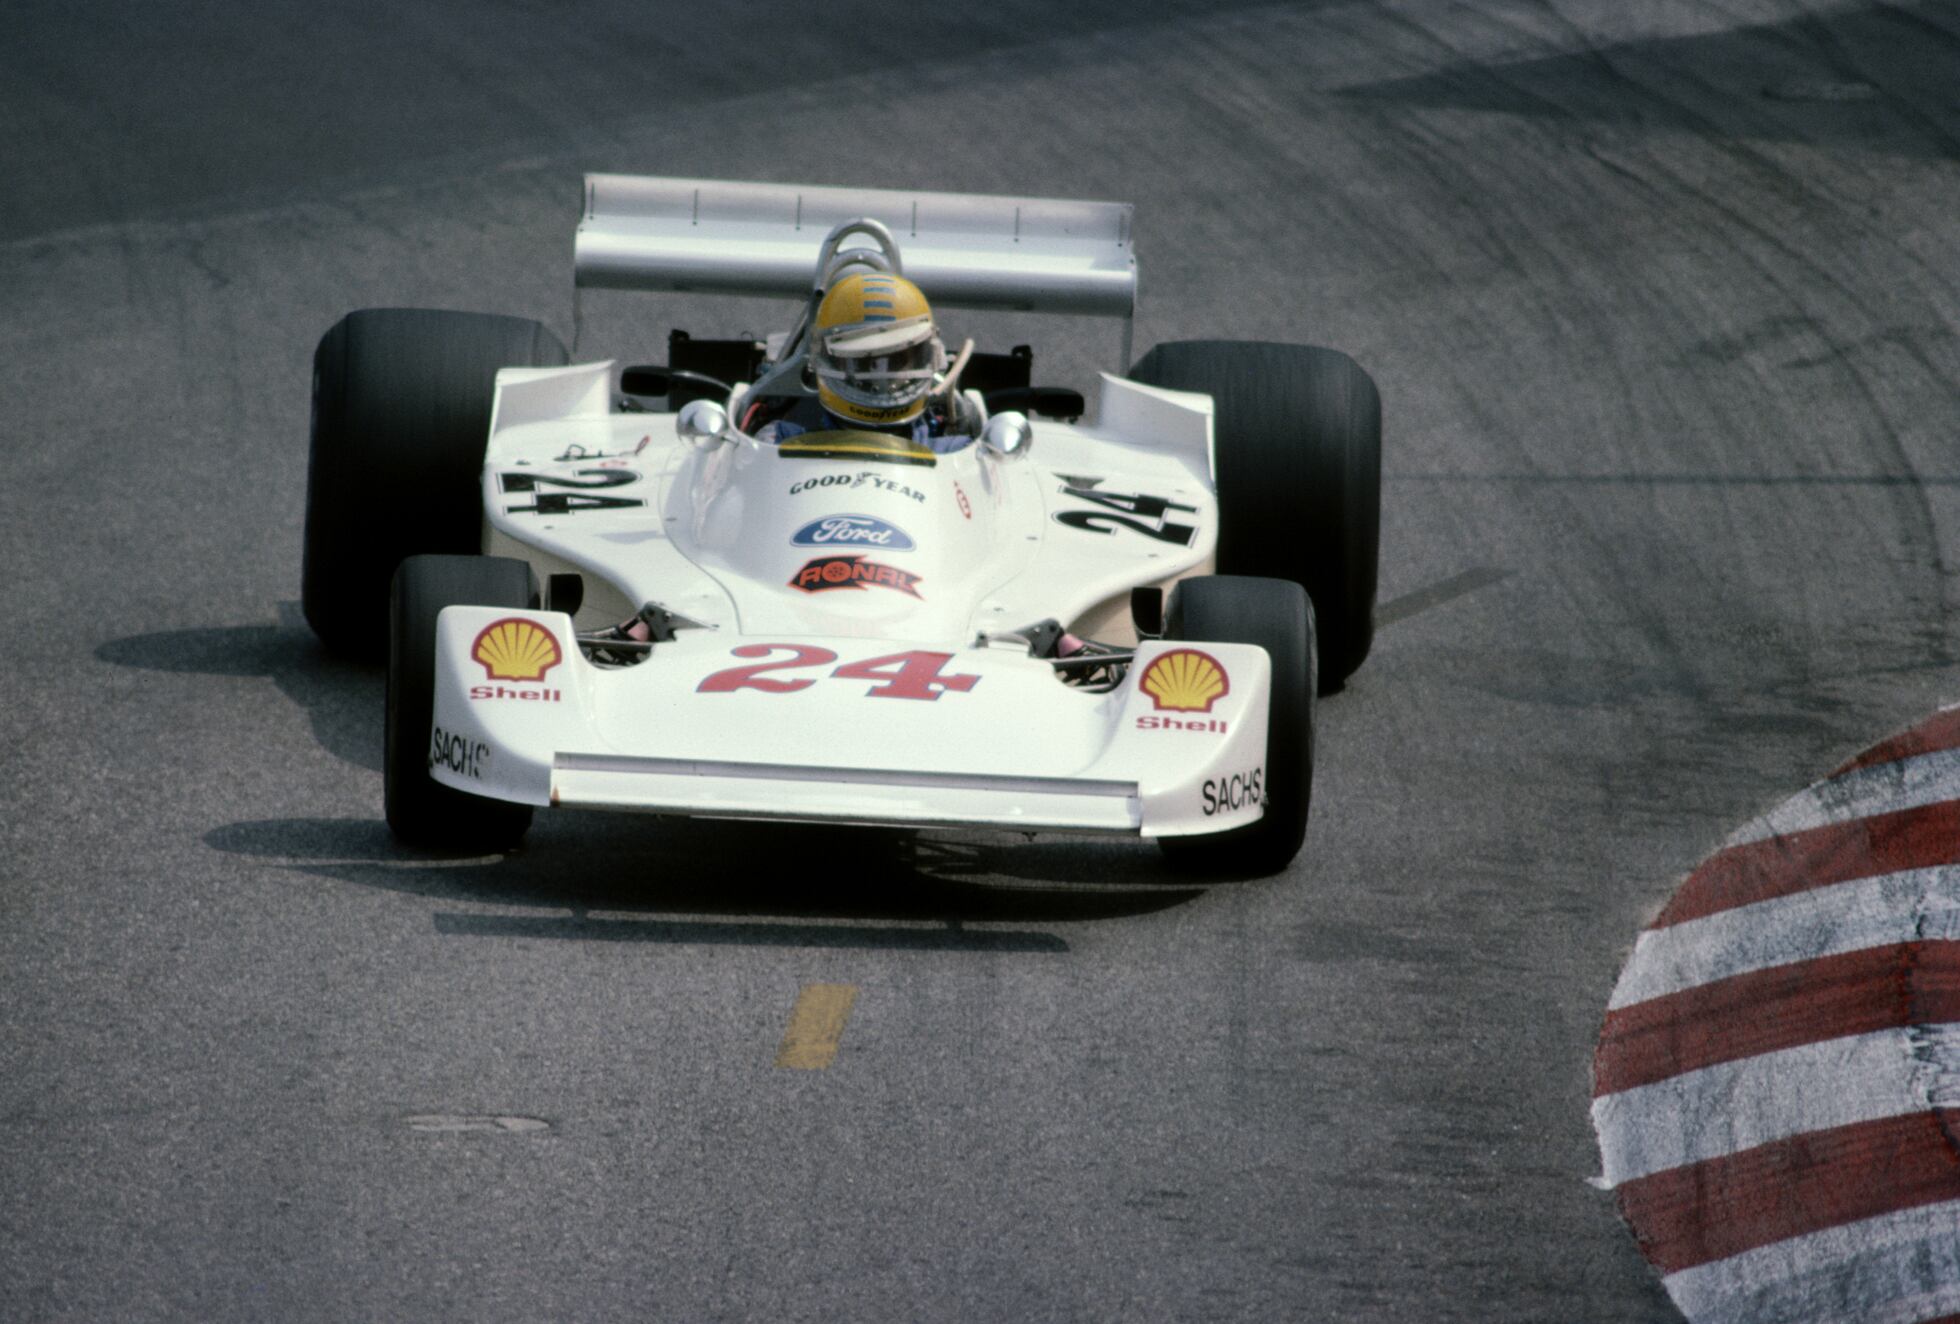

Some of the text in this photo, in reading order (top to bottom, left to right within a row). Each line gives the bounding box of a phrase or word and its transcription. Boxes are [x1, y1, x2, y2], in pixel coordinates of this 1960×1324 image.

[496, 469, 648, 515] 24
[811, 518, 892, 545] Ford
[1051, 484, 1201, 548] 24
[798, 560, 915, 592] RONAL
[695, 642, 983, 702] 24
[470, 686, 561, 702] Shell
[1136, 716, 1228, 734] Shell
[1202, 767, 1262, 816] SACHS
